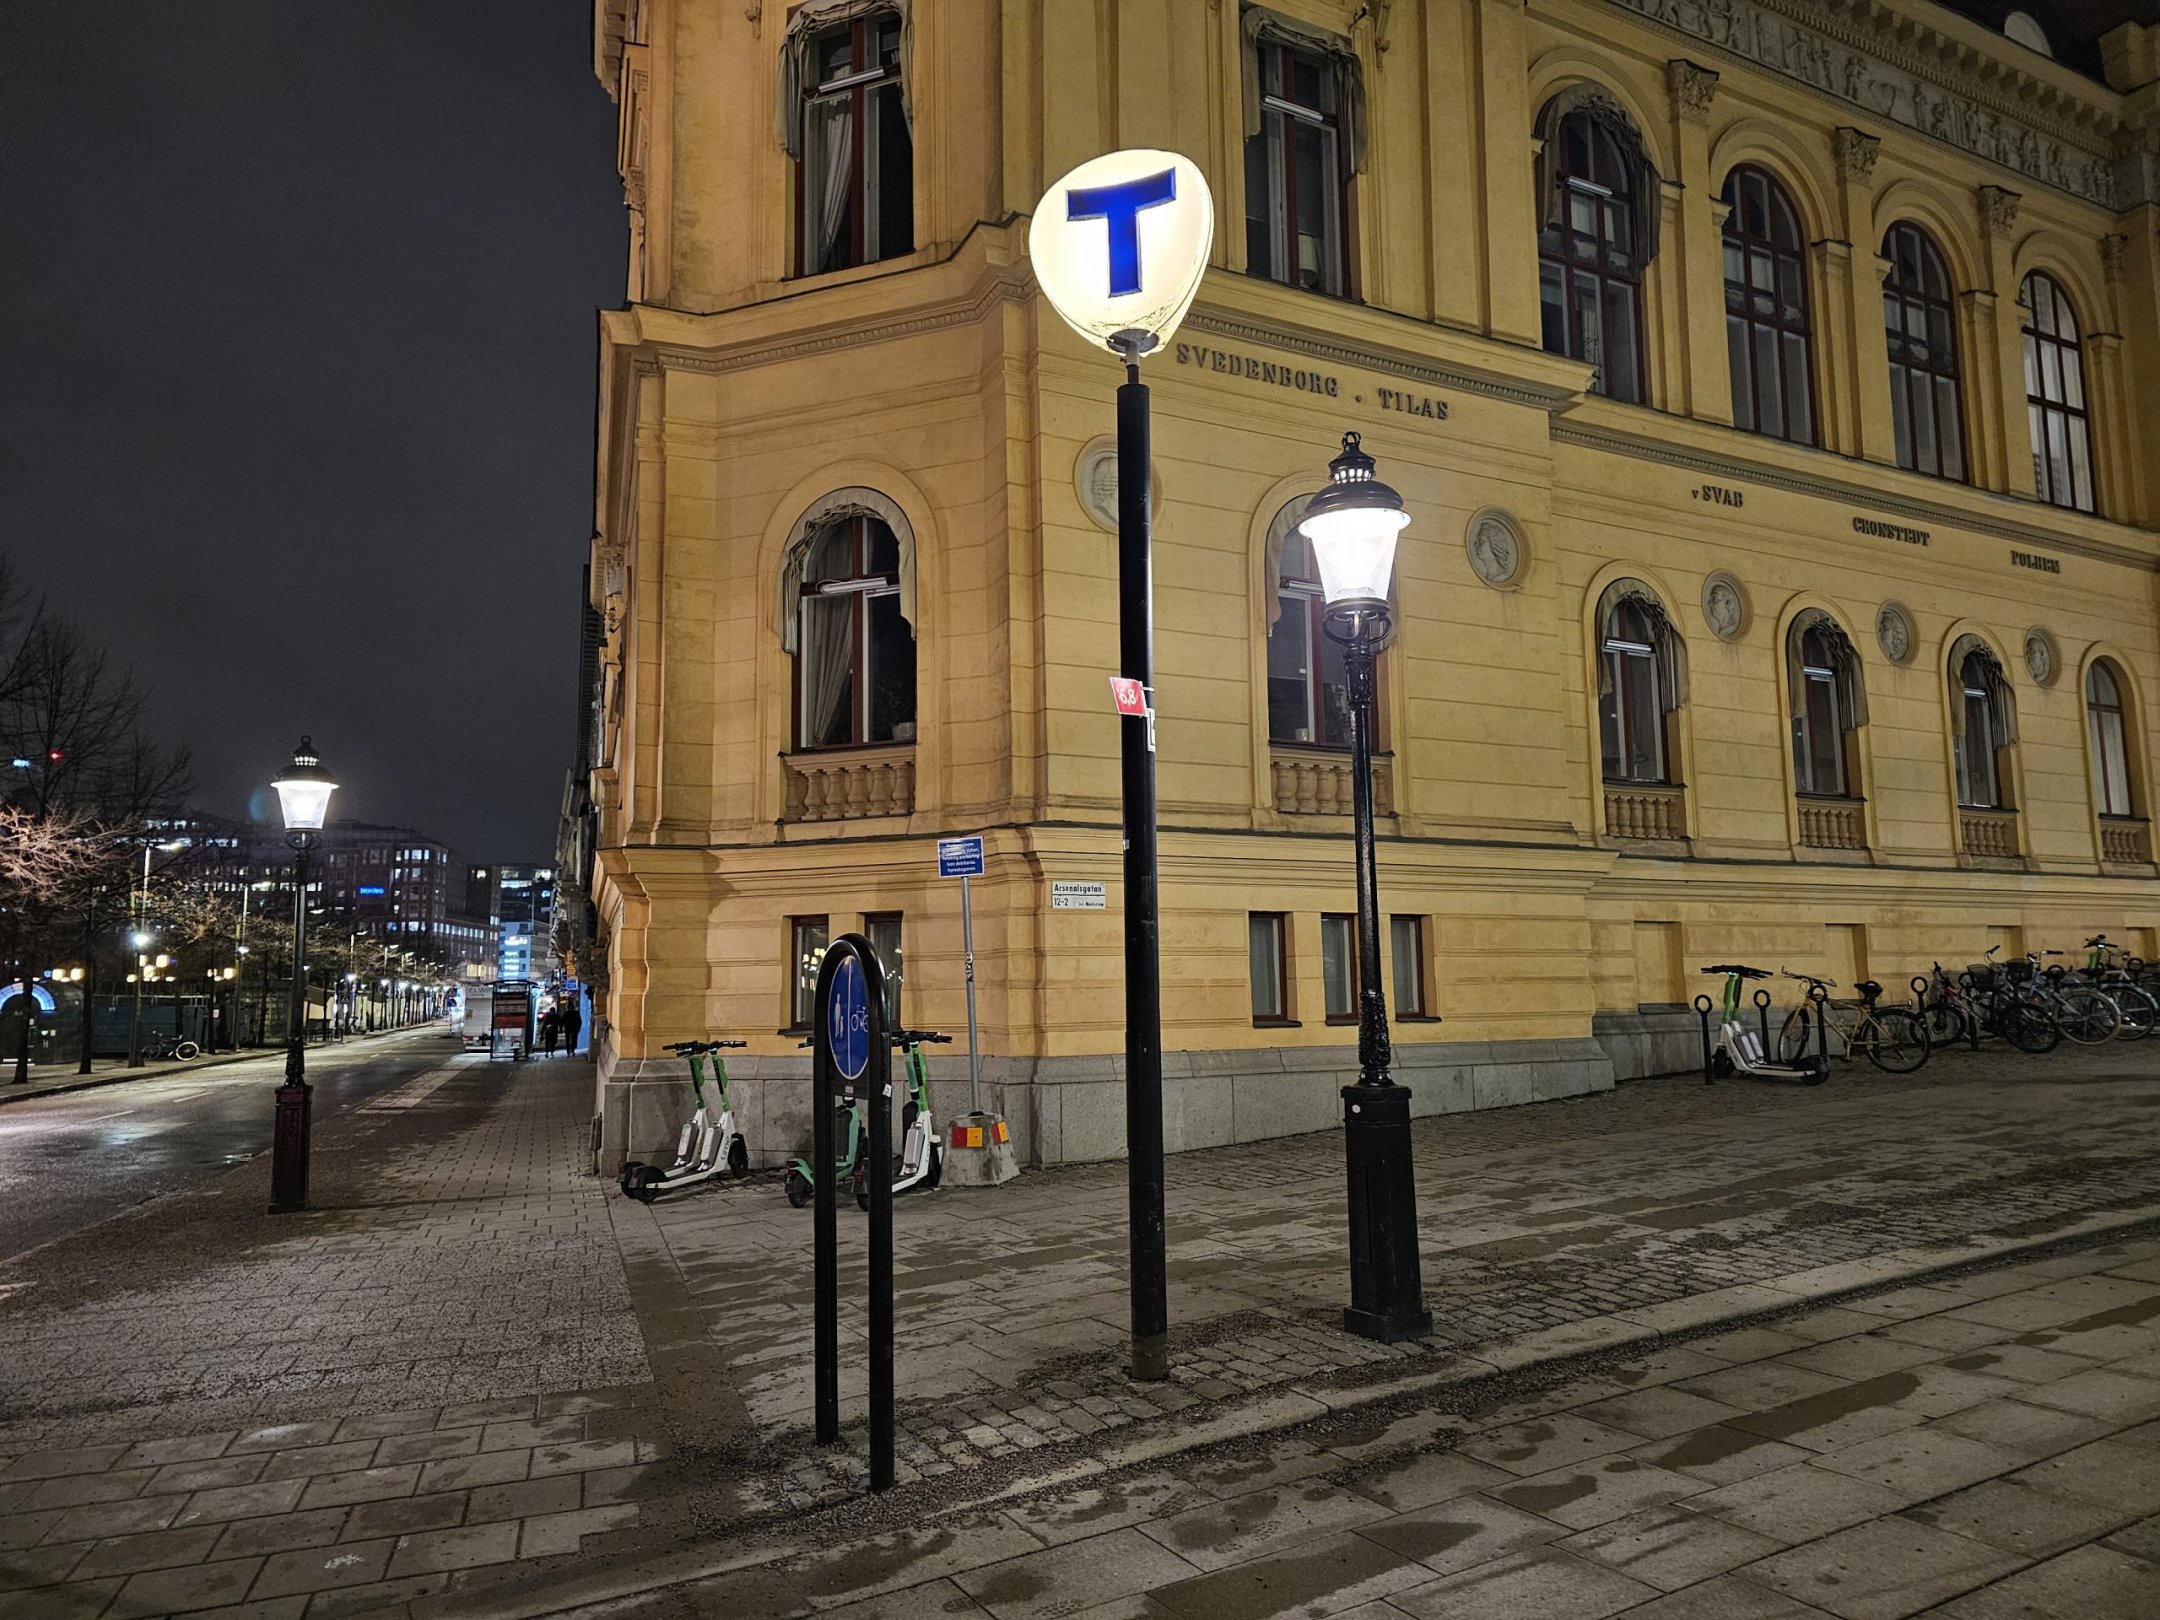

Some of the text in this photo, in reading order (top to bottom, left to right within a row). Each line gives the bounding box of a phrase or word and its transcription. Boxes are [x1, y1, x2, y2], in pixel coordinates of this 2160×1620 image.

[1065, 167, 1176, 299] T
[1176, 343, 1450, 421] SVEDENBORG TILAS
[1852, 516, 1930, 547] CRONSTEDT
[1054, 883, 1102, 895] Arsenalsgatan
[1054, 897, 1069, 906] 12-2
